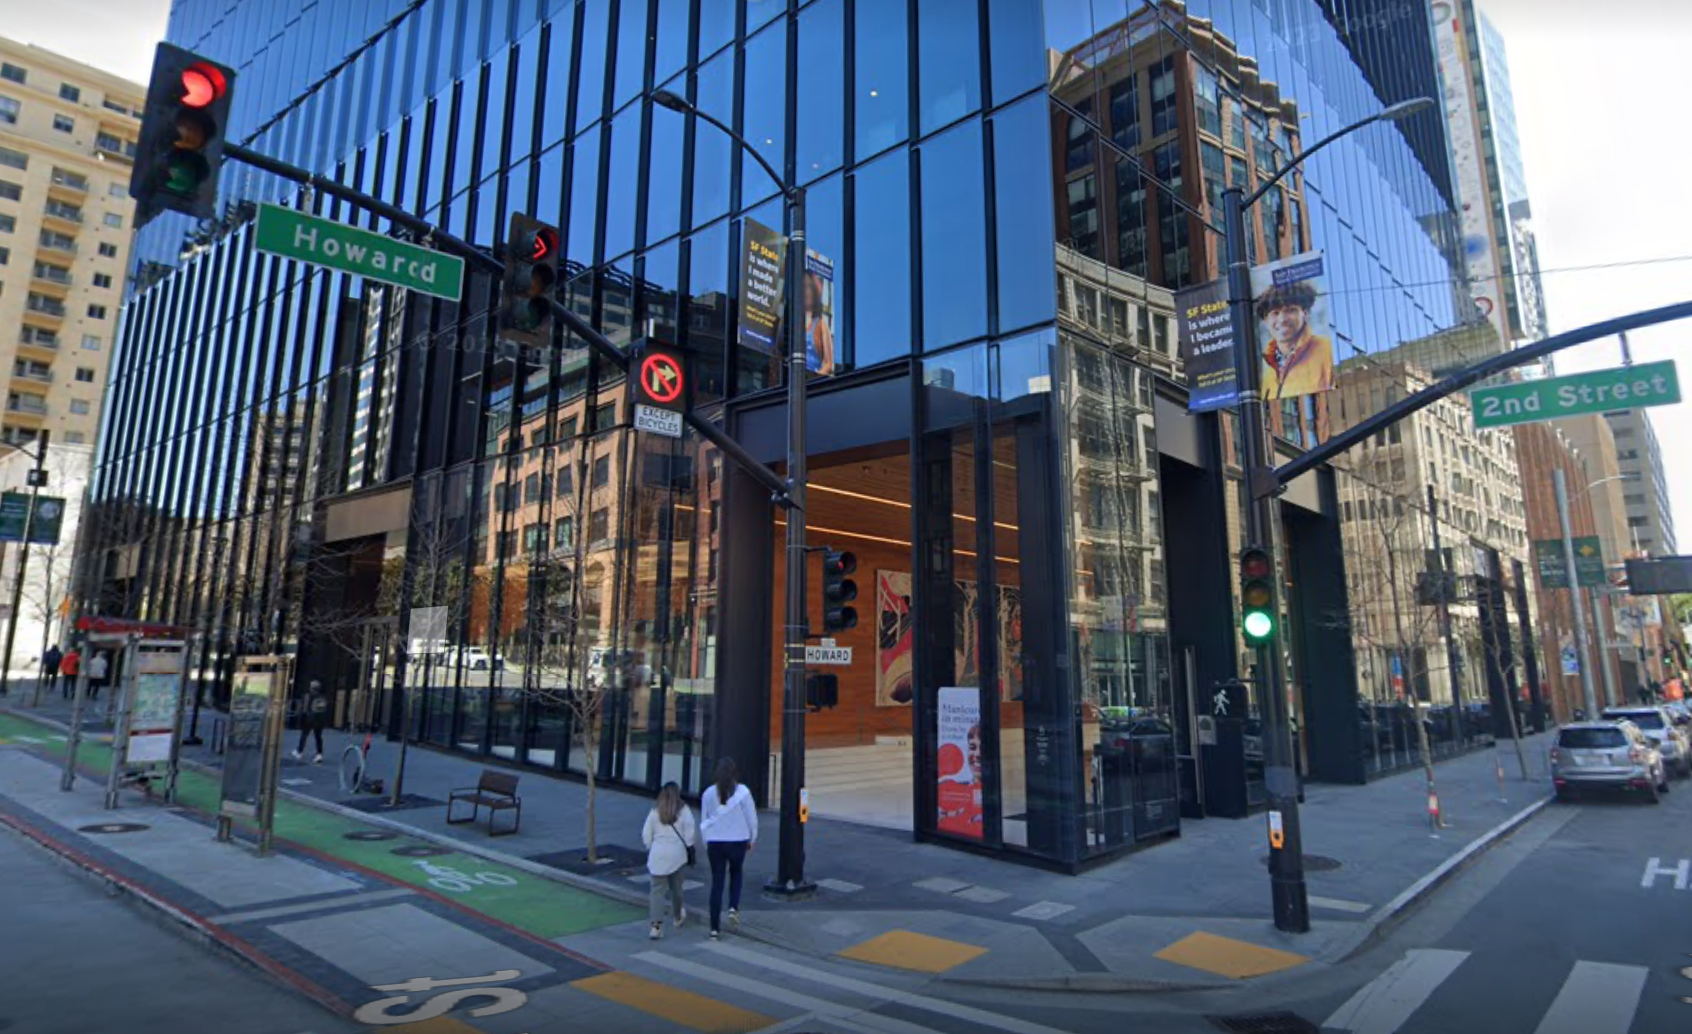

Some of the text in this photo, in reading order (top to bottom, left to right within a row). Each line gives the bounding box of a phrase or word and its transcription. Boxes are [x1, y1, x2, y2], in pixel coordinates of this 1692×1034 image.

[753, 268, 773, 283] made
[754, 280, 777, 297] better
[1186, 306, 1198, 318] SF
[1188, 320, 1197, 331] is
[1482, 373, 1668, 417] 2nd Street
[643, 406, 675, 421] EXCEPT
[639, 416, 678, 433] BICYCLES
[807, 649, 849, 661] HOWARD
